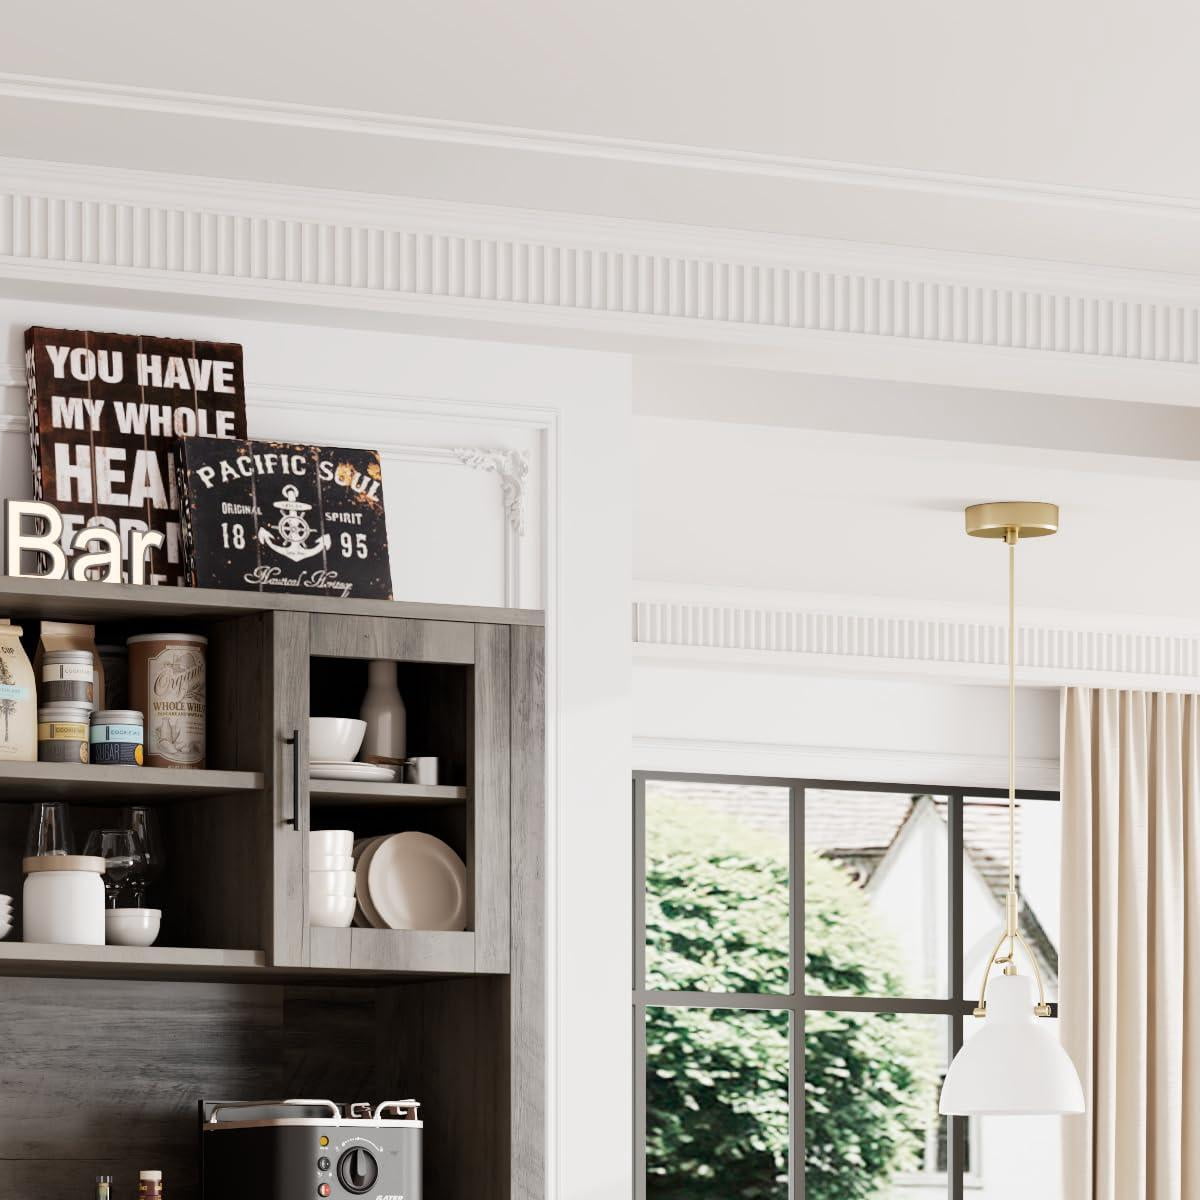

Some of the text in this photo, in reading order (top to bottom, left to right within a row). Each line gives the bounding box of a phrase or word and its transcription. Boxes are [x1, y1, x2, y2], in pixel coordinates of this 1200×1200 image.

[46, 345, 235, 394] YOU HAVE
[51, 395, 235, 440] MY WHOLE
[54, 442, 179, 511] HEA
[196, 453, 381, 502] PACIFIC SOUL
[221, 501, 363, 525] ORIGINAL SPIRIT
[6, 499, 166, 585] Bar
[220, 522, 368, 560] 18 95
[152, 701, 185, 711] WHOLE
